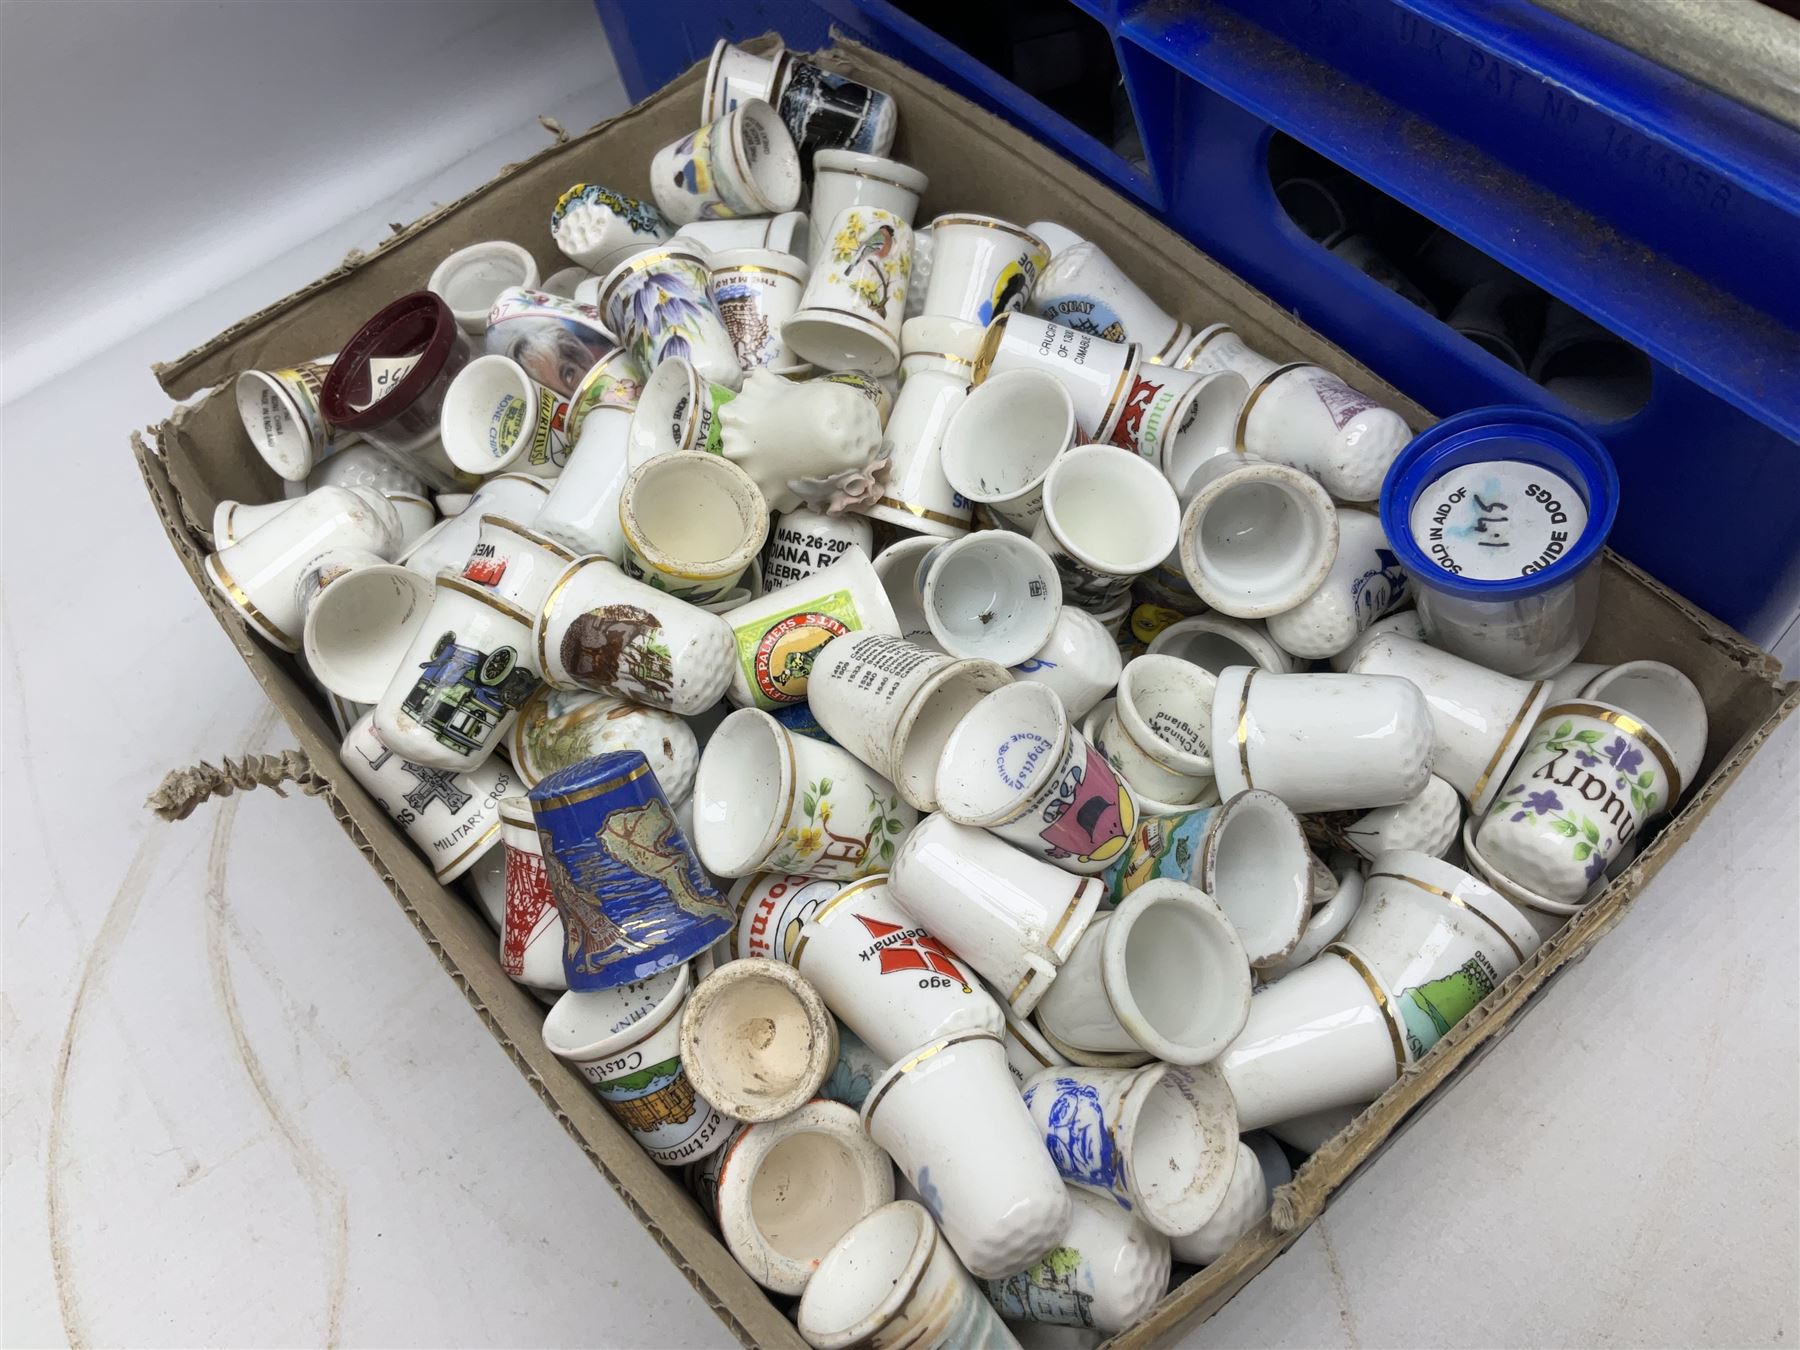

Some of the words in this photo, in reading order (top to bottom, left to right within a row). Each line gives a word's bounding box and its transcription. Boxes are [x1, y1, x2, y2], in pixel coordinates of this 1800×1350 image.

[715, 276, 748, 289] MARY
[1058, 300, 1096, 316] QUAY
[1057, 344, 1069, 358] OF
[531, 388, 552, 459] MAURITIUS
[1141, 393, 1175, 458] Cymru
[1448, 486, 1468, 504] OF
[1524, 483, 1568, 525] DOGS
[1432, 503, 1451, 526] AID
[1430, 527, 1443, 541] IN
[1431, 543, 1463, 577] SOLD
[1521, 531, 1568, 577] GUIDE
[758, 618, 797, 671] PALMERS
[1010, 733, 1042, 742] BONE
[1155, 711, 1199, 744] England
[1163, 725, 1193, 752] China
[1198, 740, 1207, 753] in
[997, 756, 1014, 788] CHINA
[433, 810, 486, 852] MILITARY
[484, 773, 510, 810] CROSS
[858, 928, 928, 962] Denmark
[919, 976, 951, 989] ago
